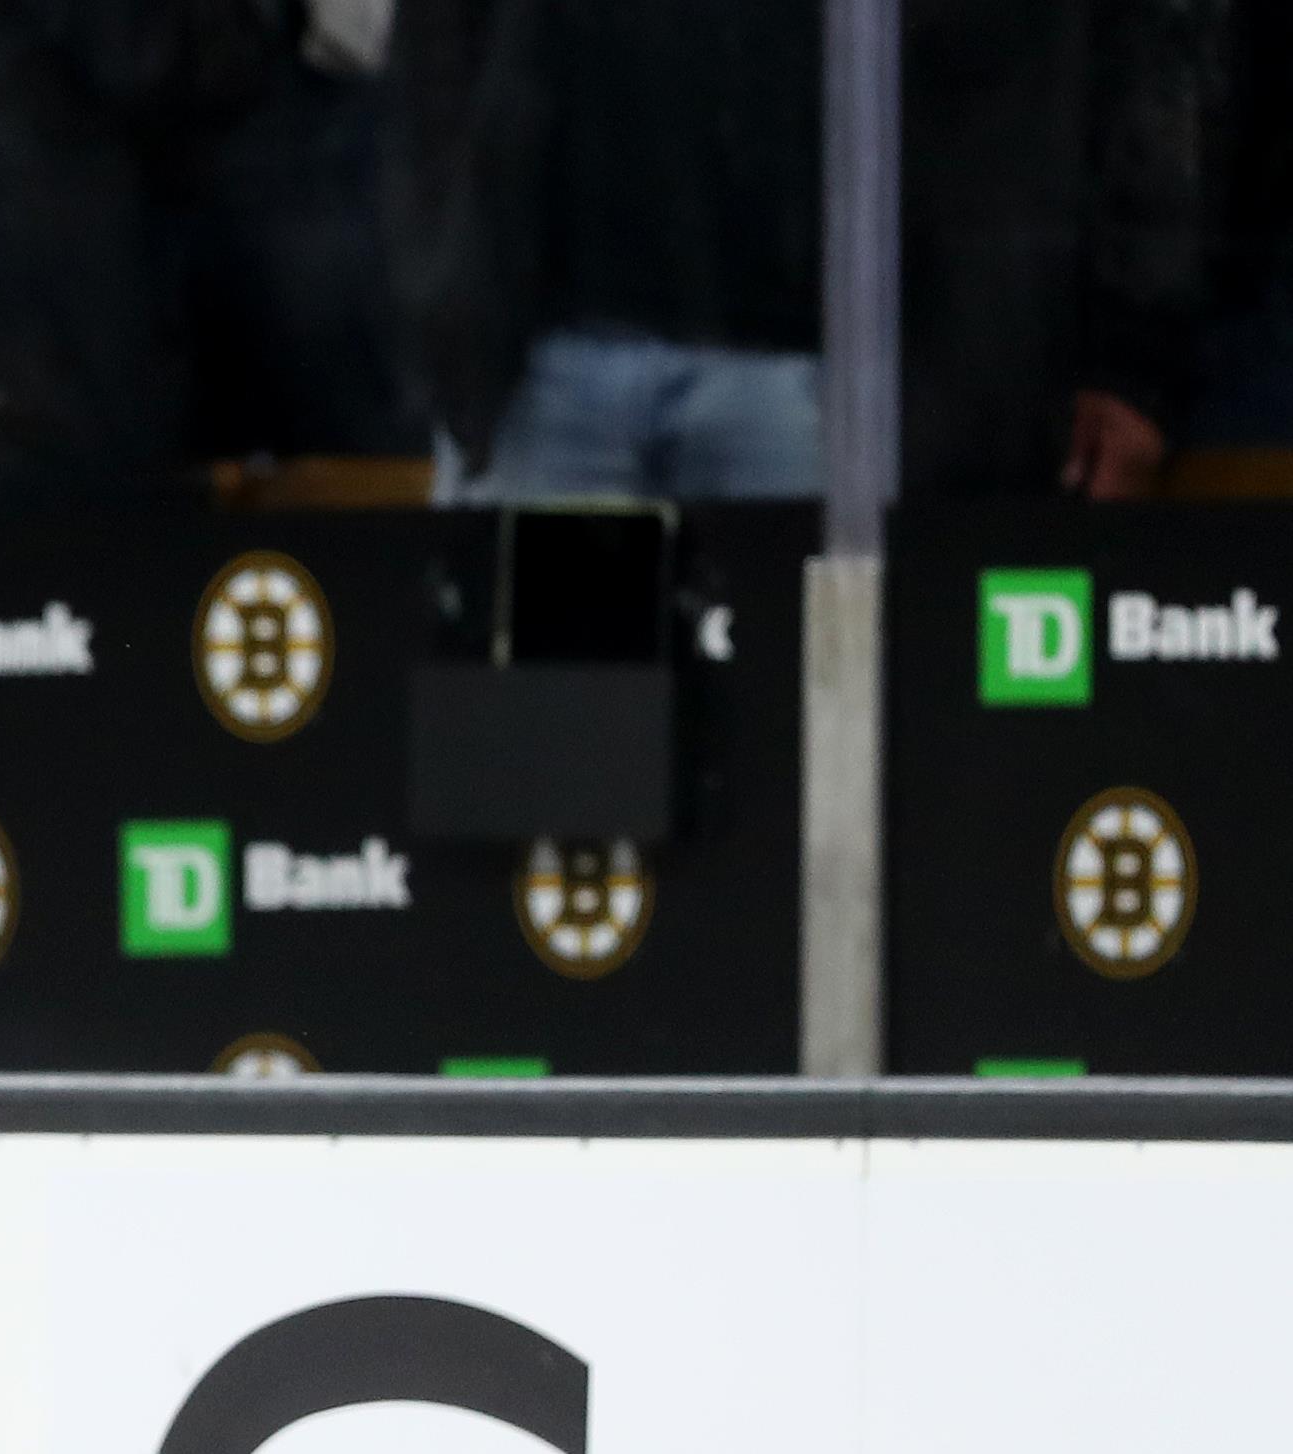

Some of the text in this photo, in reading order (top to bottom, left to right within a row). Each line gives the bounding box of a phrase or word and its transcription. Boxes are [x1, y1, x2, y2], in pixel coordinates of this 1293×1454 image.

[991, 589, 1279, 681] TD Bank
[126, 836, 410, 935] TD Bank
